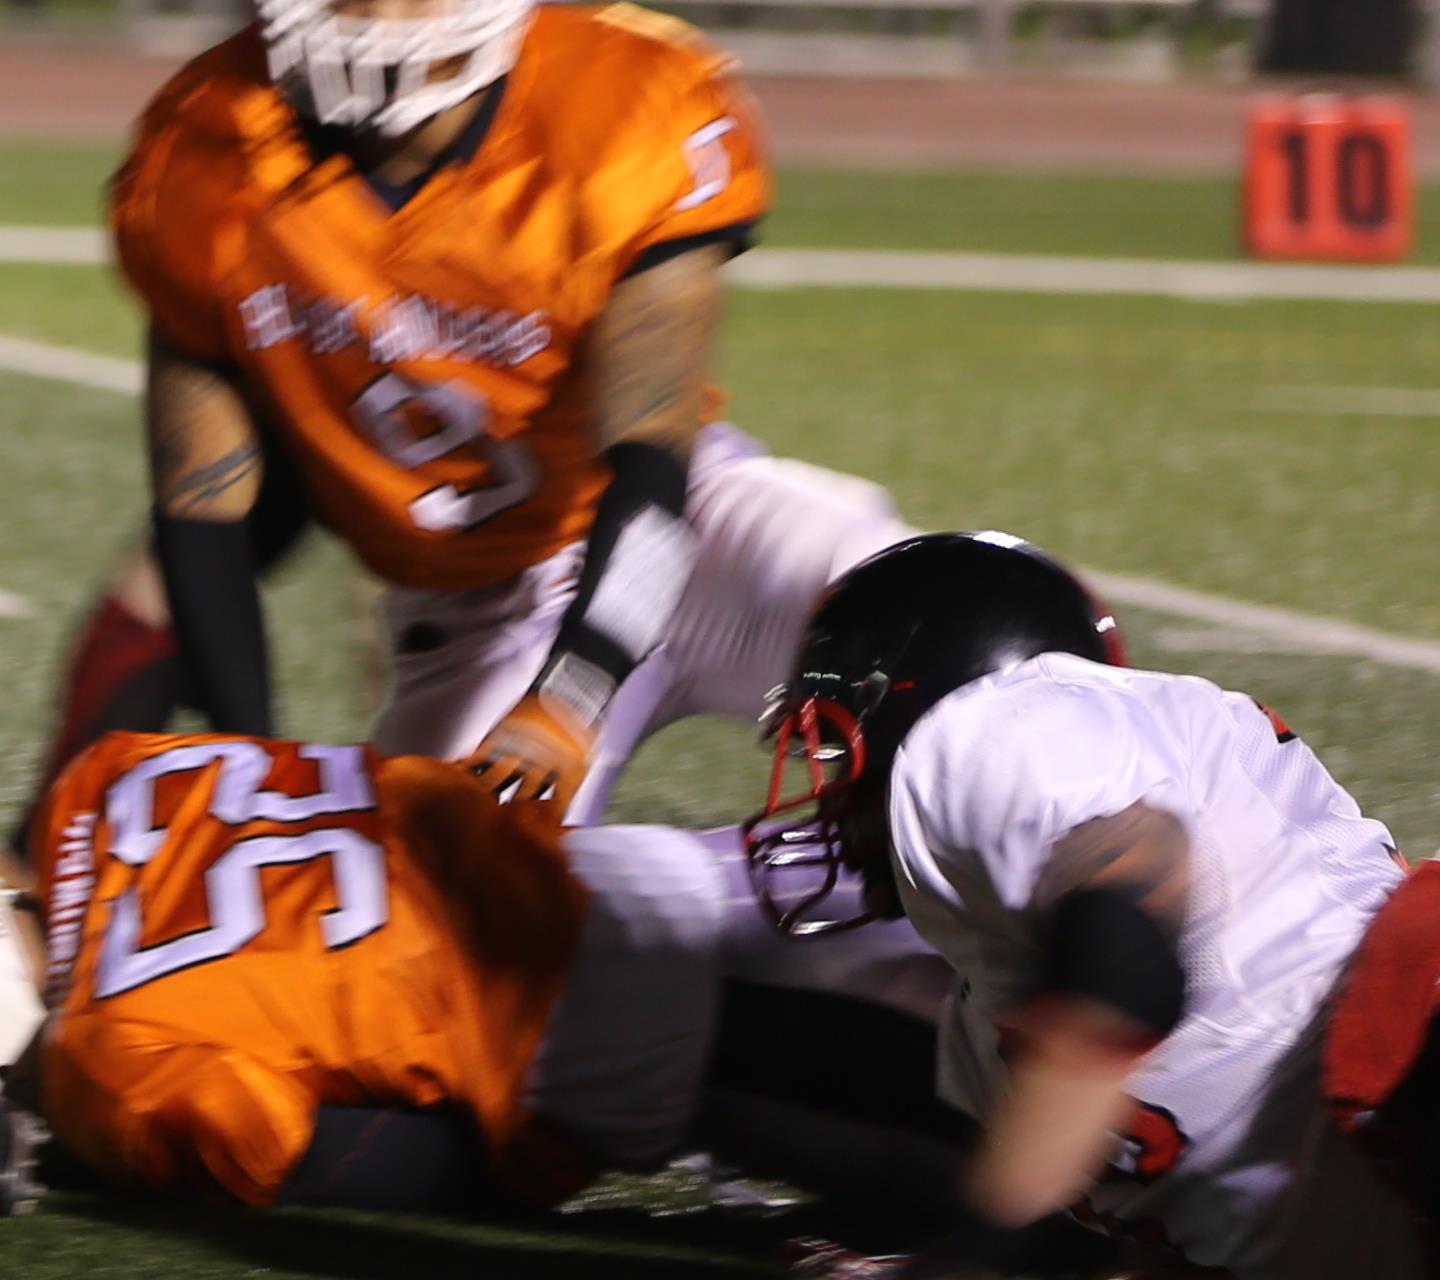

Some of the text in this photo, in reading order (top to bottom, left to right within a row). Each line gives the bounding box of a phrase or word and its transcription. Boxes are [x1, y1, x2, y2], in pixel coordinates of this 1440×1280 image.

[1279, 130, 1391, 233] 10
[347, 368, 544, 534] 9
[95, 740, 389, 1000] 52
